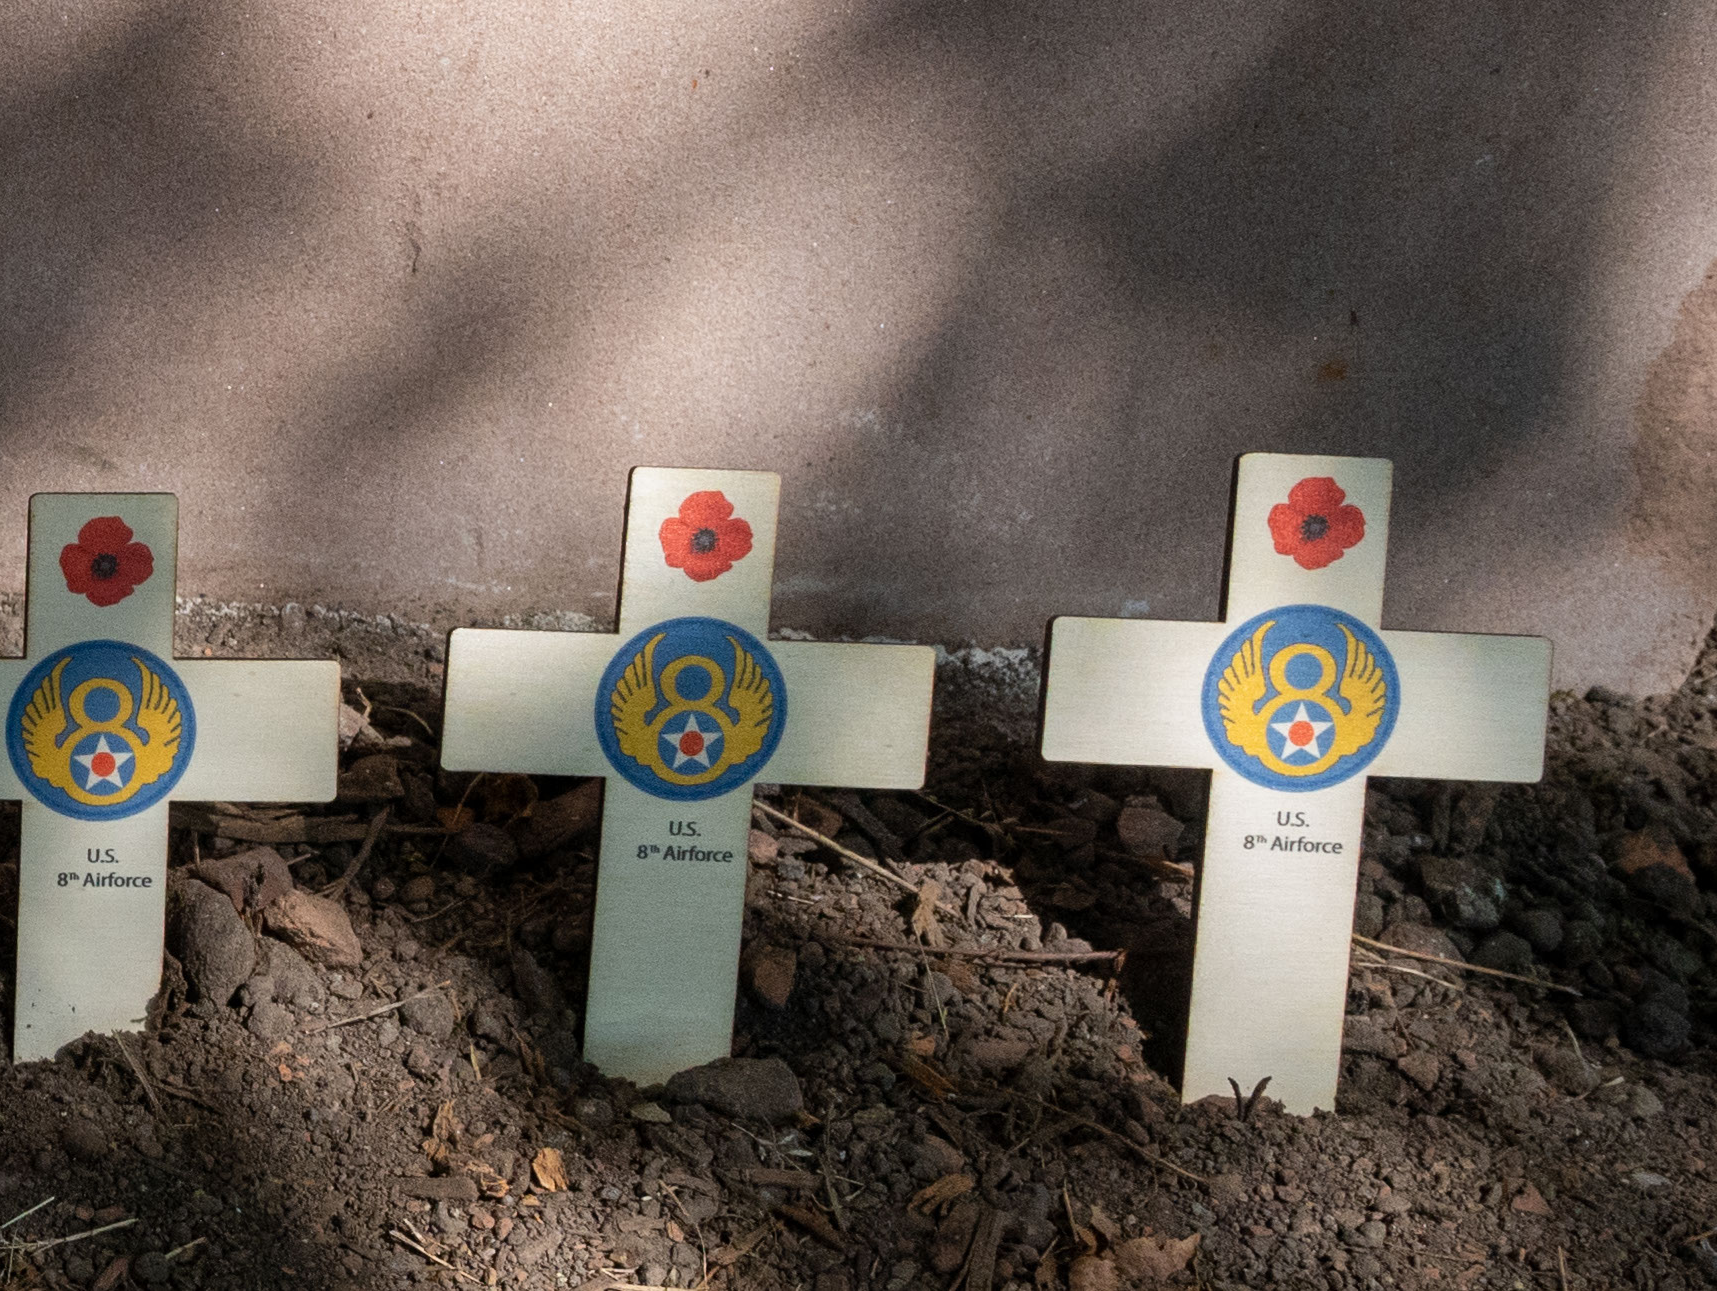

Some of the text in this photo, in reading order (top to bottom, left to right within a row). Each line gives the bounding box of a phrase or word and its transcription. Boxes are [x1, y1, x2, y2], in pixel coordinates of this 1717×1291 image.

[1277, 811, 1309, 827] U.S.
[669, 821, 701, 836] U.S.
[1271, 836, 1343, 854] Airforce
[88, 849, 118, 863] U.S.
[663, 846, 733, 862] Airforce
[83, 872, 152, 887] Airforce
